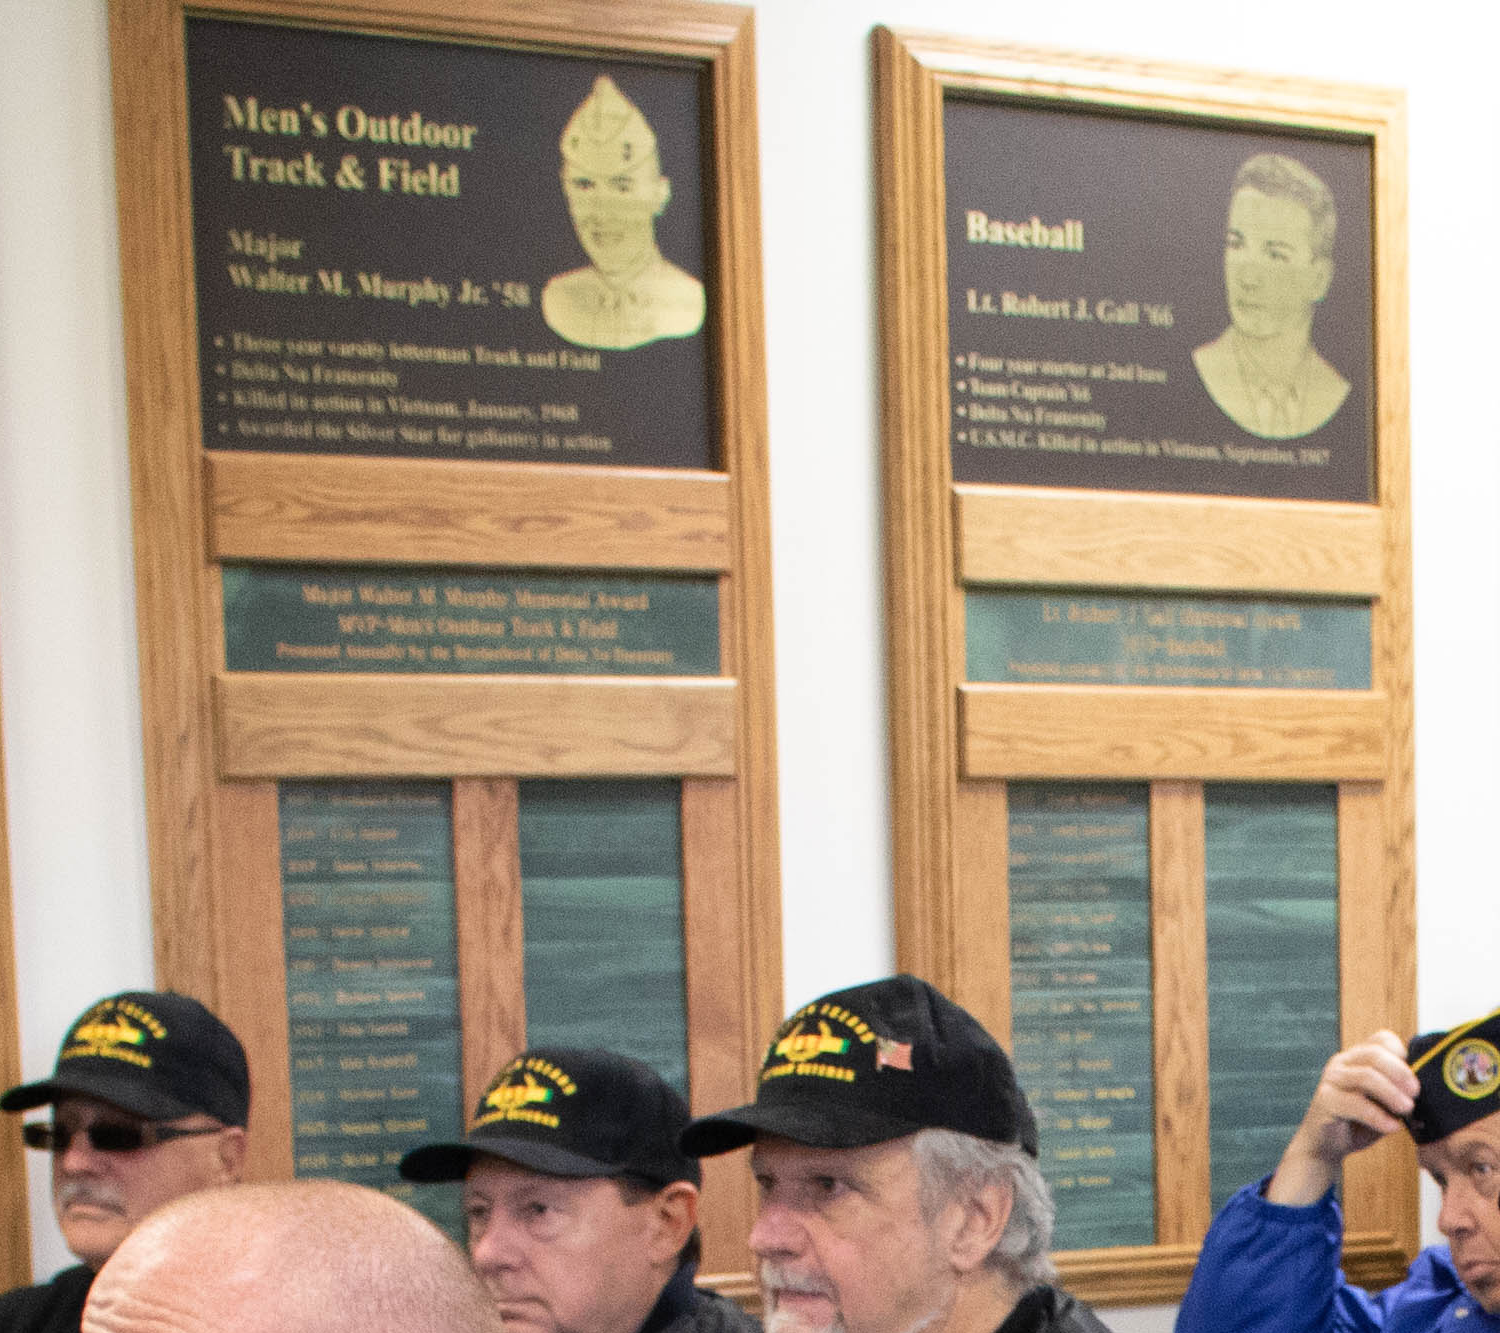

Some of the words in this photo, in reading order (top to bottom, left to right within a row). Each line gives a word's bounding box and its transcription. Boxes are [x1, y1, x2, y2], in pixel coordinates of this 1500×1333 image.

[223, 95, 329, 140] Men's
[336, 103, 478, 151] Outdoor
[224, 145, 326, 188] Track
[334, 157, 366, 191] &
[378, 157, 461, 198] Field
[226, 228, 304, 261] Major
[965, 210, 1084, 252] Baseball
[226, 263, 312, 296] Walter
[357, 272, 450, 309] Murphy
[1001, 291, 1070, 319] Robert
